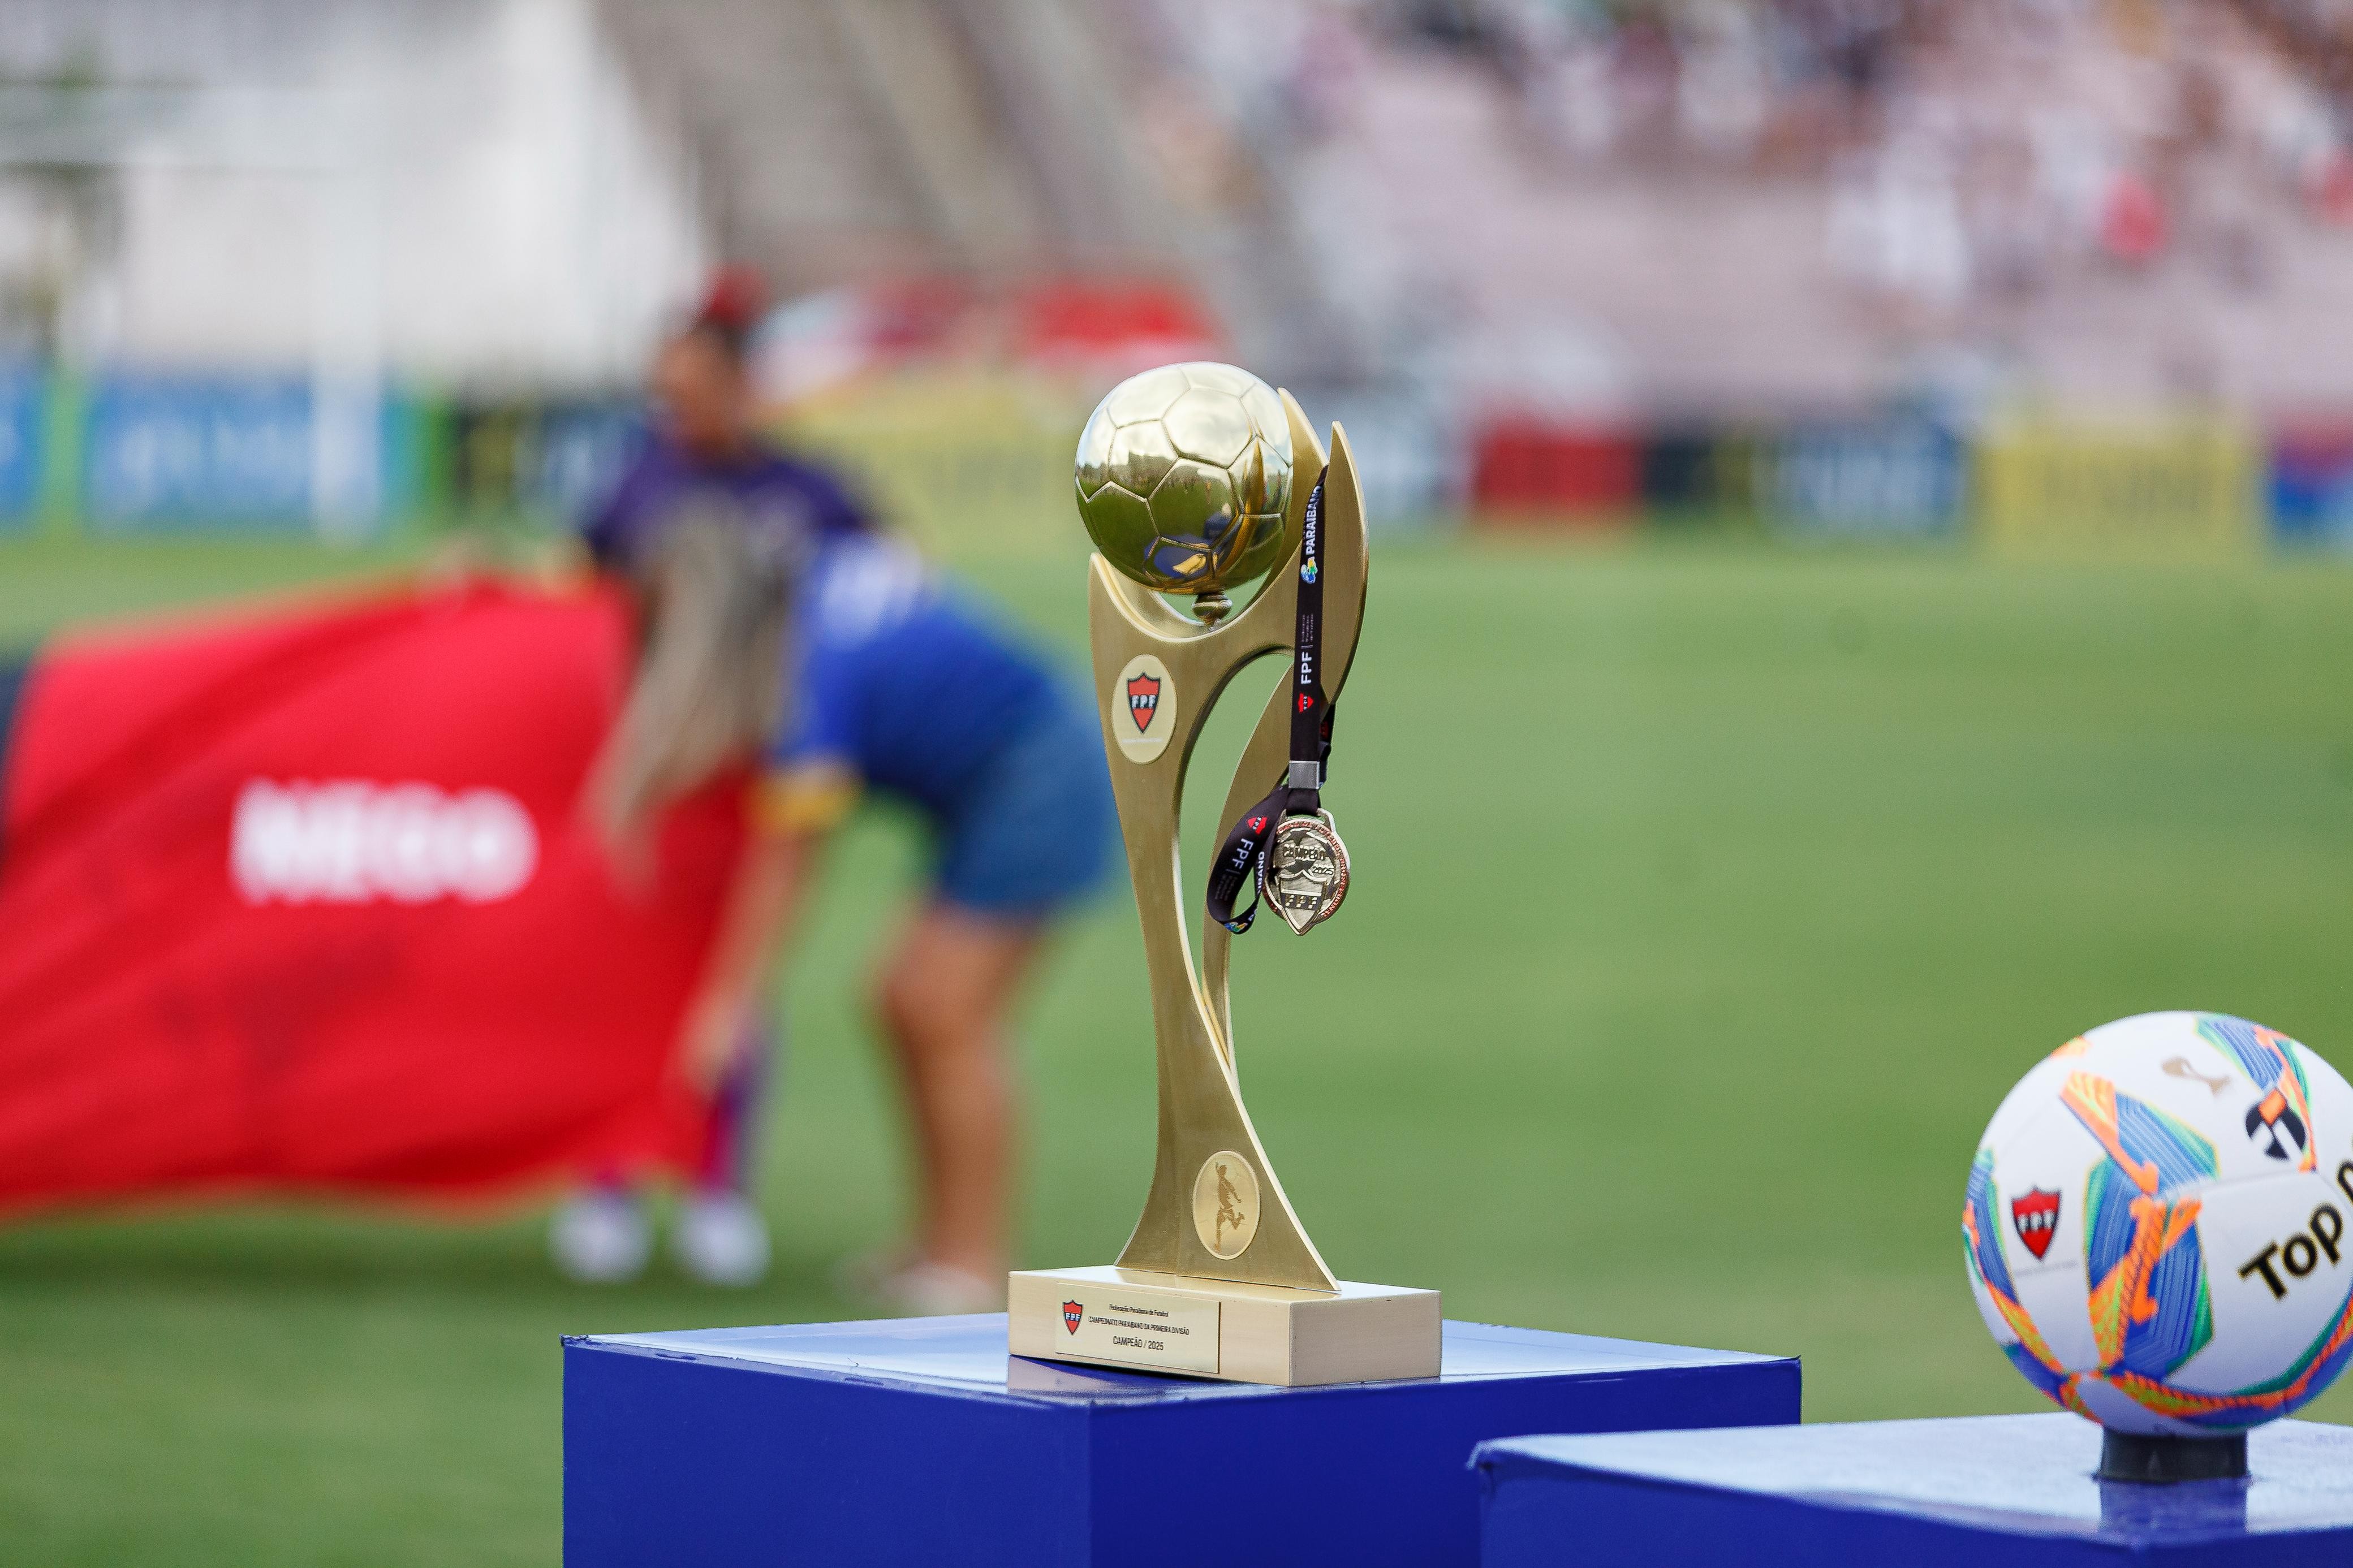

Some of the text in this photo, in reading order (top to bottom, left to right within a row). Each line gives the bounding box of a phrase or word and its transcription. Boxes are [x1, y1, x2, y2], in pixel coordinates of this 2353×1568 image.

[1302, 651, 1312, 684] FPF
[1132, 694, 1156, 709] FPF
[1232, 838, 1254, 869] FPF
[1312, 866, 1334, 875] 2025
[1285, 895, 1318, 909] FPF
[1065, 1312, 1080, 1321] FPF
[1171, 1327, 1190, 1335] DIVISÃO
[1113, 1336, 1143, 1347] CAMPEÃO
[1148, 1340, 1163, 1350] 2025
